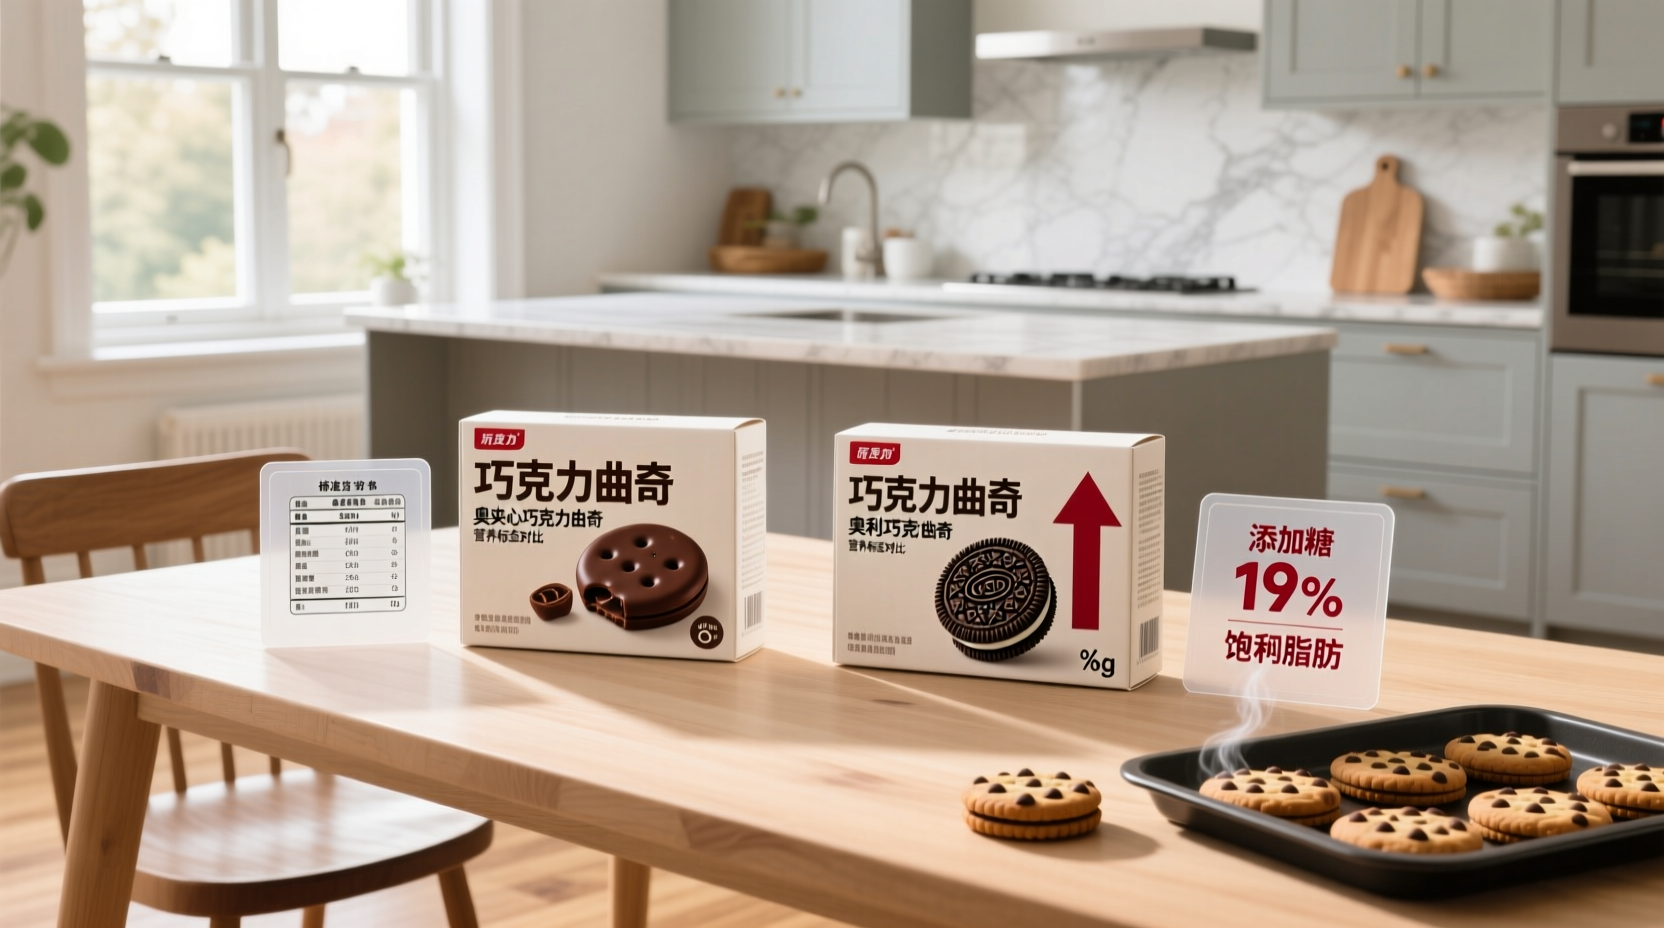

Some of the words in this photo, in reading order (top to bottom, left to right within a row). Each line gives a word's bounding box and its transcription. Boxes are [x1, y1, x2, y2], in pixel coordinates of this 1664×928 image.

[474, 459, 673, 505] 巧克力曲奇
[849, 475, 1022, 518] 巧克力曲奇
[848, 516, 953, 540] 奥利巧克曲奇
[1249, 523, 1335, 557] 添加糖
[1235, 561, 1343, 618] 19%
[1080, 649, 1116, 678] %g
